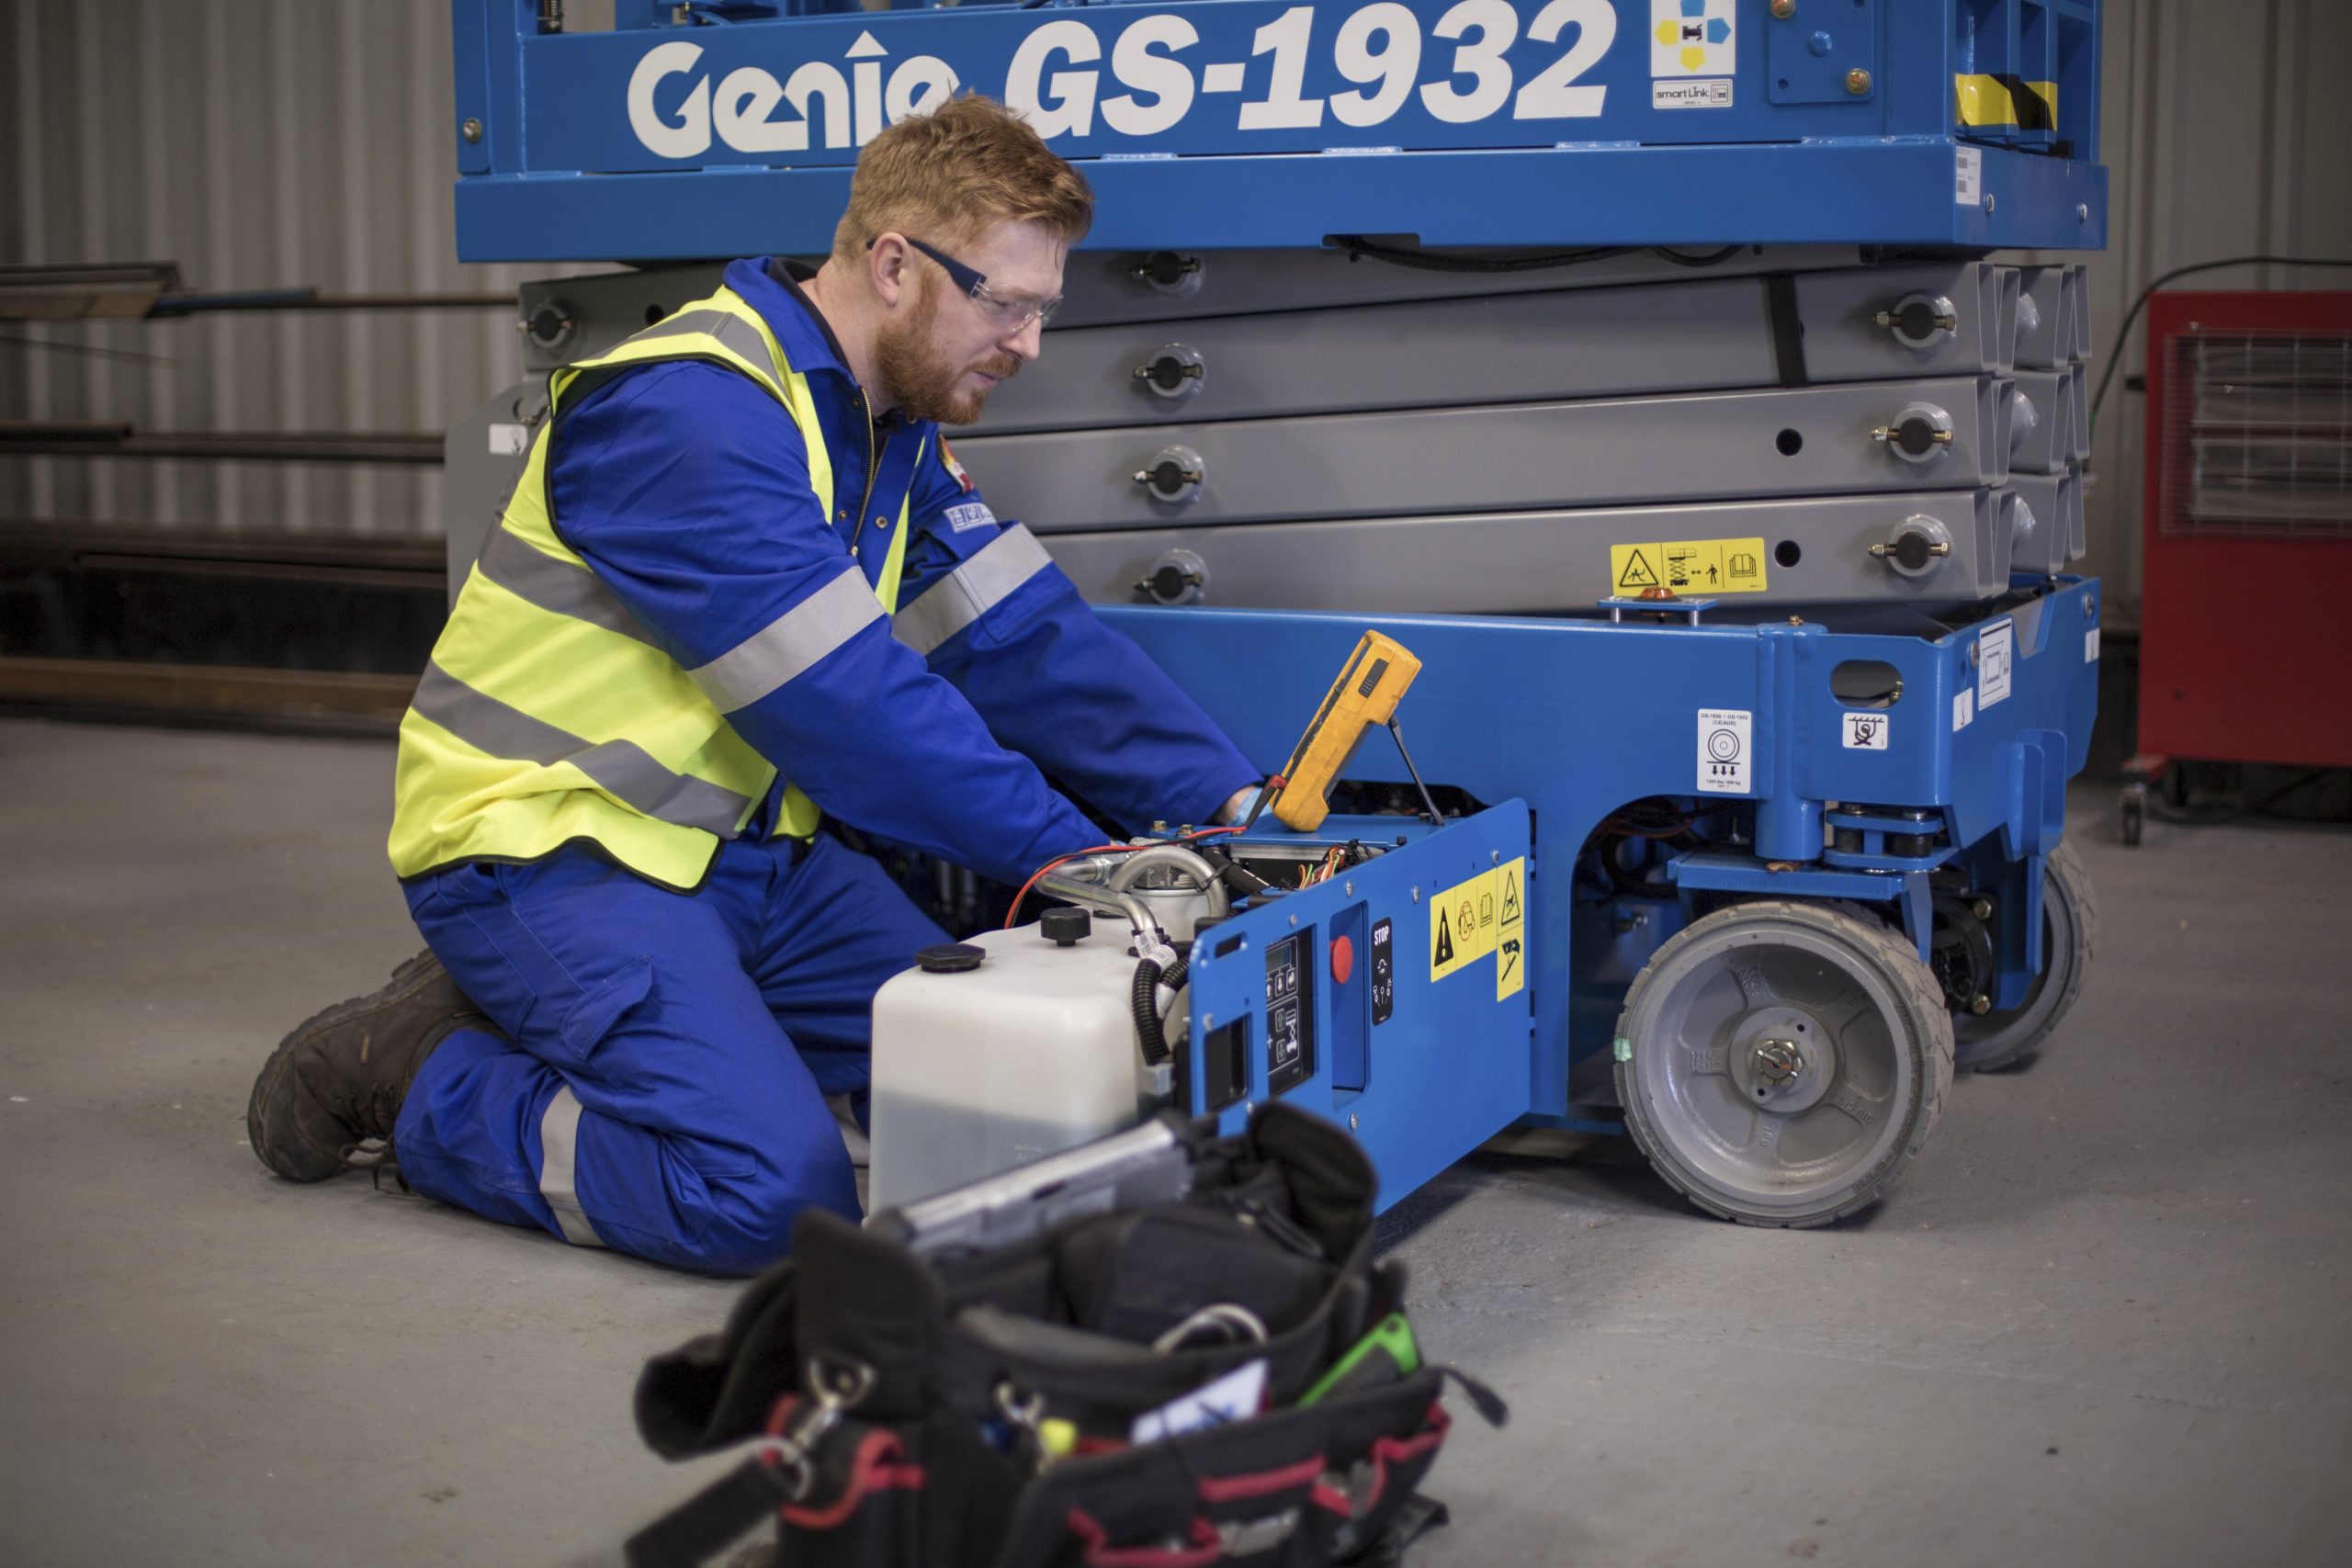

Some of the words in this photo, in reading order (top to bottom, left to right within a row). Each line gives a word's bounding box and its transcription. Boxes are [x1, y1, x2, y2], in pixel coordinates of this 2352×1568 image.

[627, 30, 960, 159] Genie
[1005, 0, 1618, 140] GS-1932
[1657, 89, 1687, 99] smart
[1374, 925, 1389, 946] STOP
